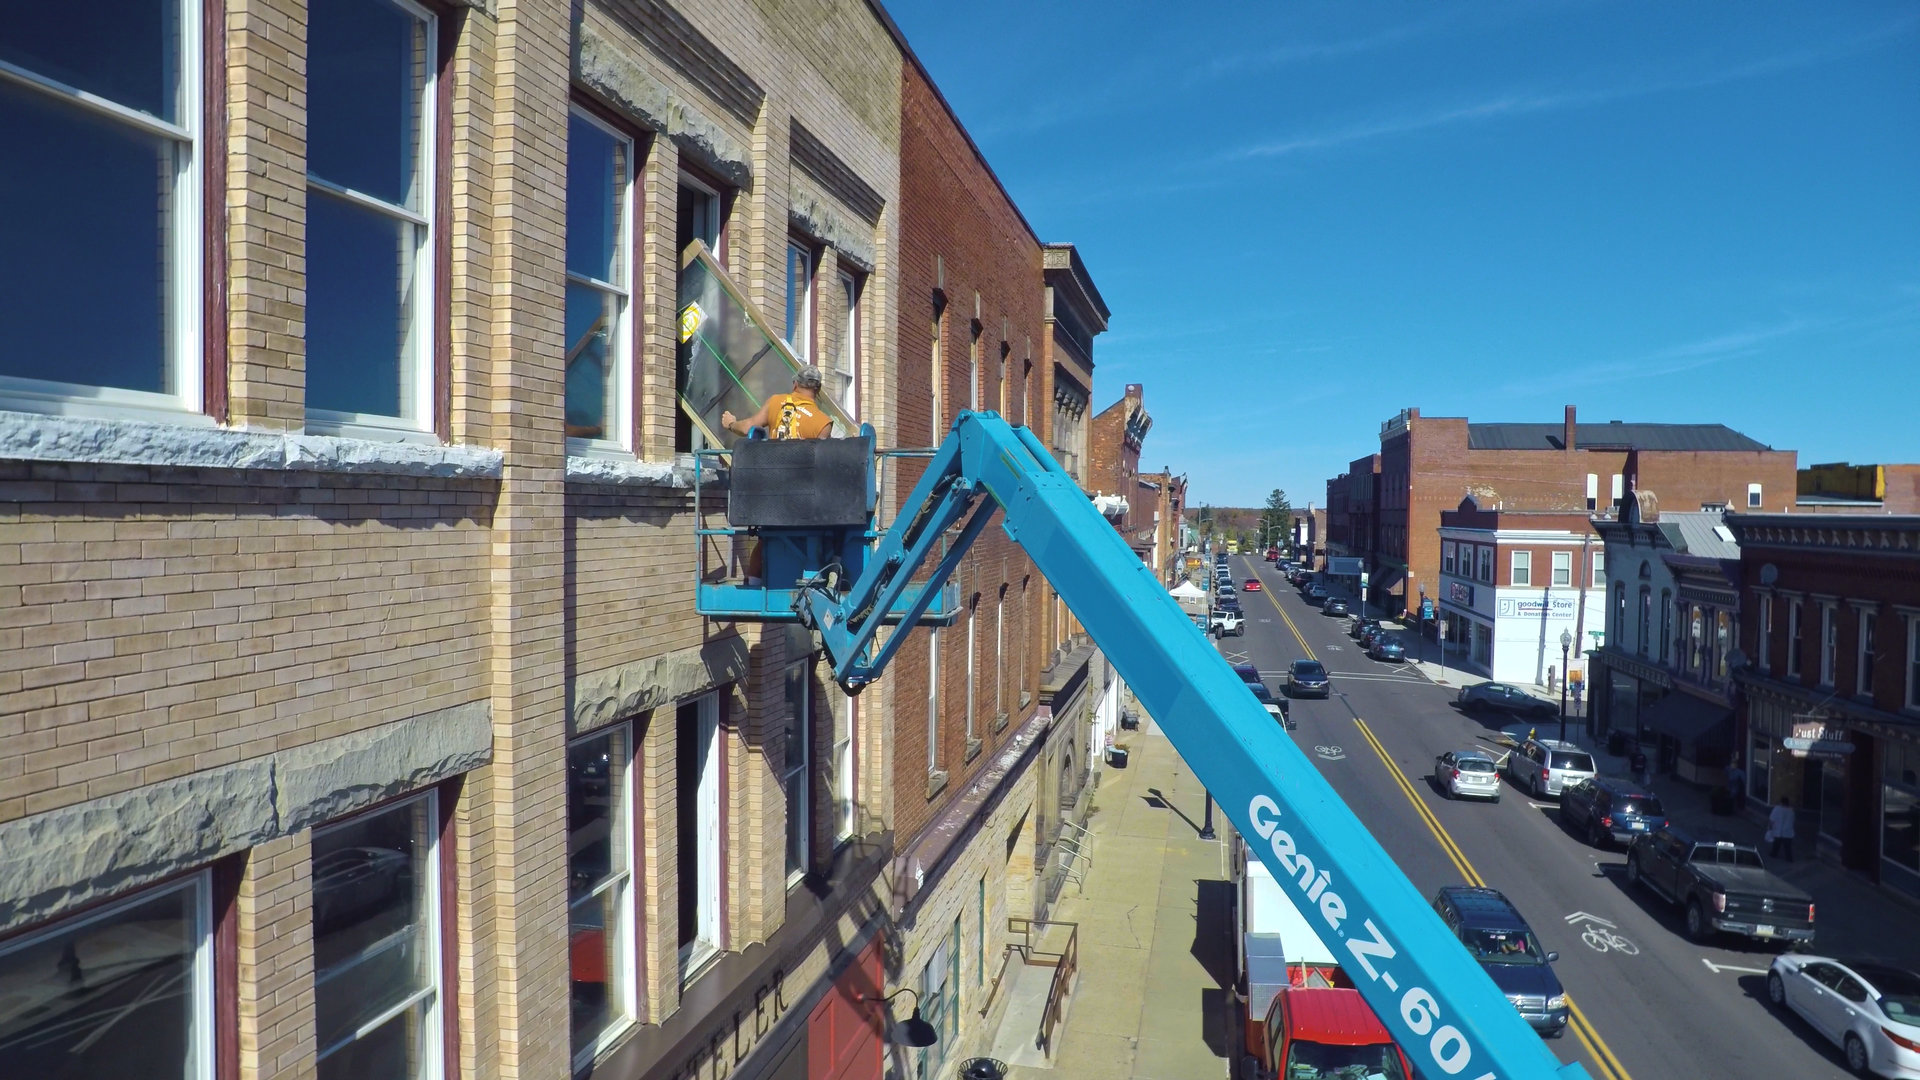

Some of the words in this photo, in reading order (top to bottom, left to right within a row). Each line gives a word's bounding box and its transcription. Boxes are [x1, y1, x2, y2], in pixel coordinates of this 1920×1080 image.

[1552, 600, 1573, 609] Store
[1817, 726, 1844, 741] Stuff
[1345, 918, 1497, 1080] Z-60
